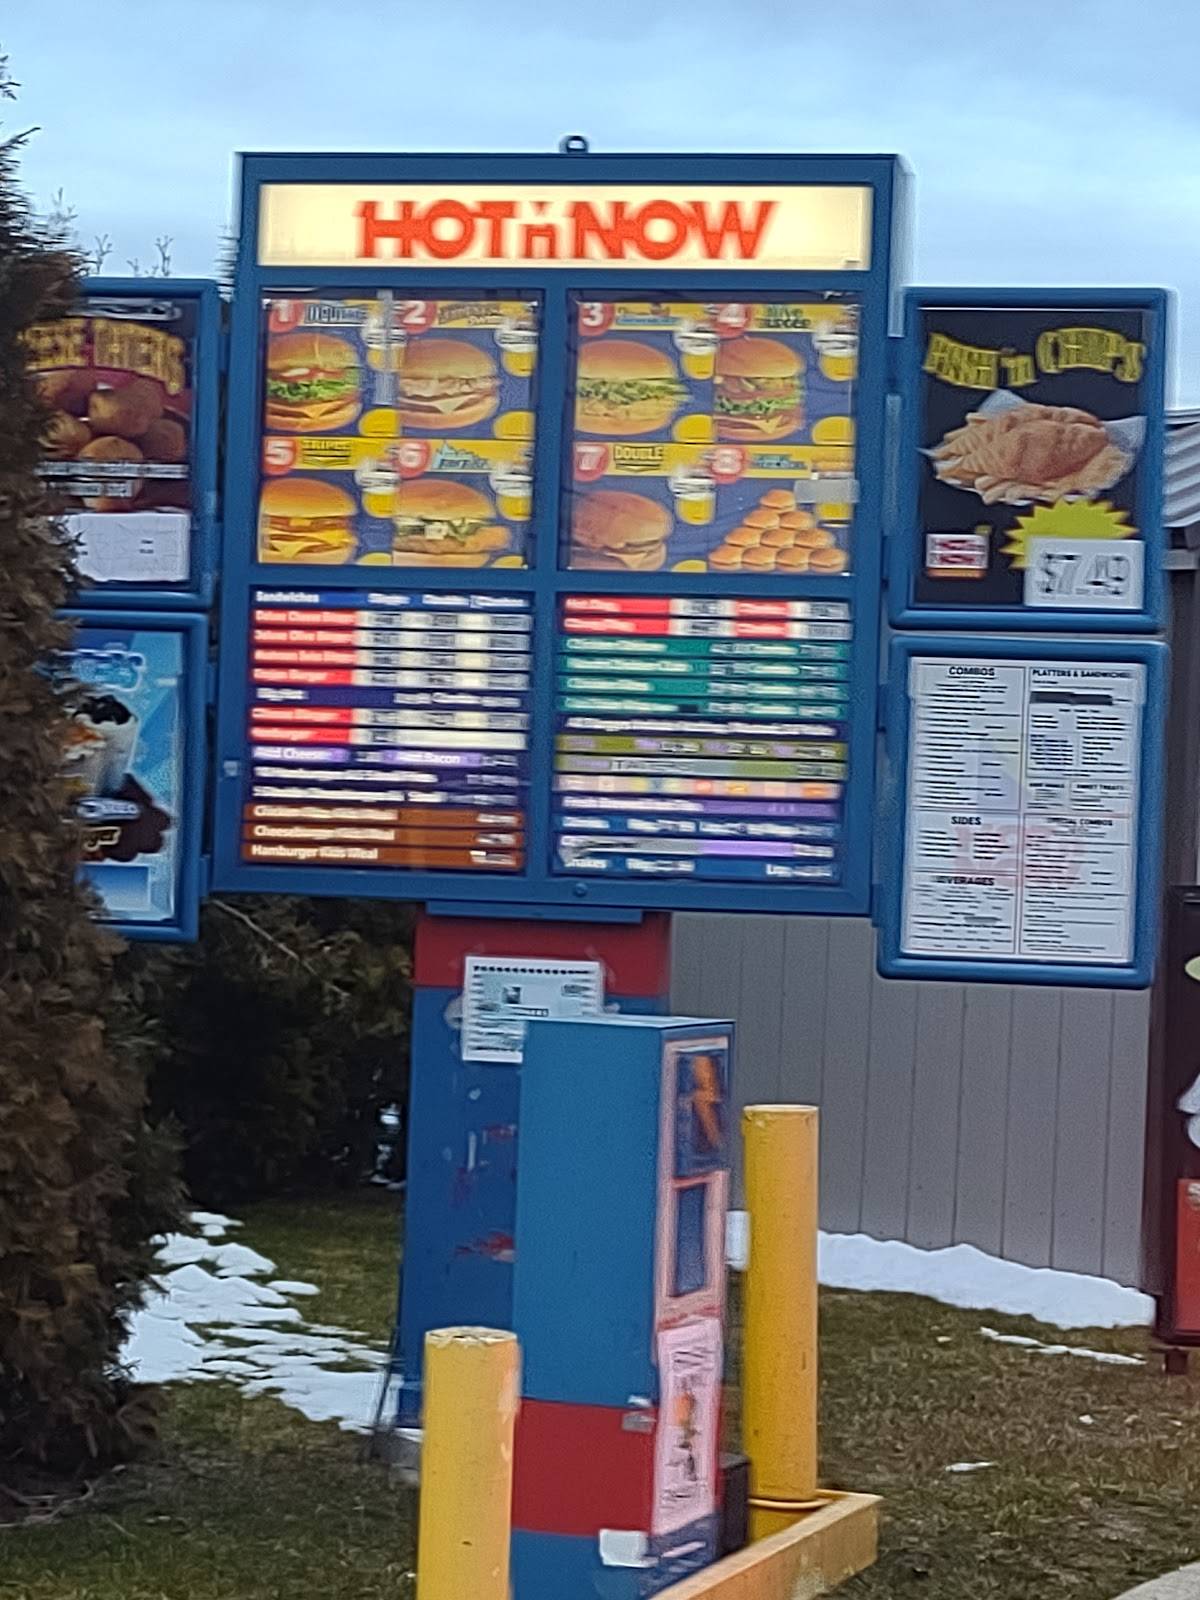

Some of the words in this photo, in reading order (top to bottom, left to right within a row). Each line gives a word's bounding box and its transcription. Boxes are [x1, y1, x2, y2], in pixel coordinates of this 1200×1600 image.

[353, 199, 517, 259] HOT
[567, 199, 778, 260] NOW
[276, 300, 292, 323] 1
[403, 301, 427, 325] 2
[582, 302, 605, 327] 3
[717, 303, 749, 328] 4
[264, 439, 294, 465] 5
[575, 445, 607, 471] 7
[614, 444, 664, 461] DOUBLE
[948, 666, 995, 676] COMBOS
[1032, 669, 1071, 677] PLATTERS
[951, 816, 982, 826] SIDES
